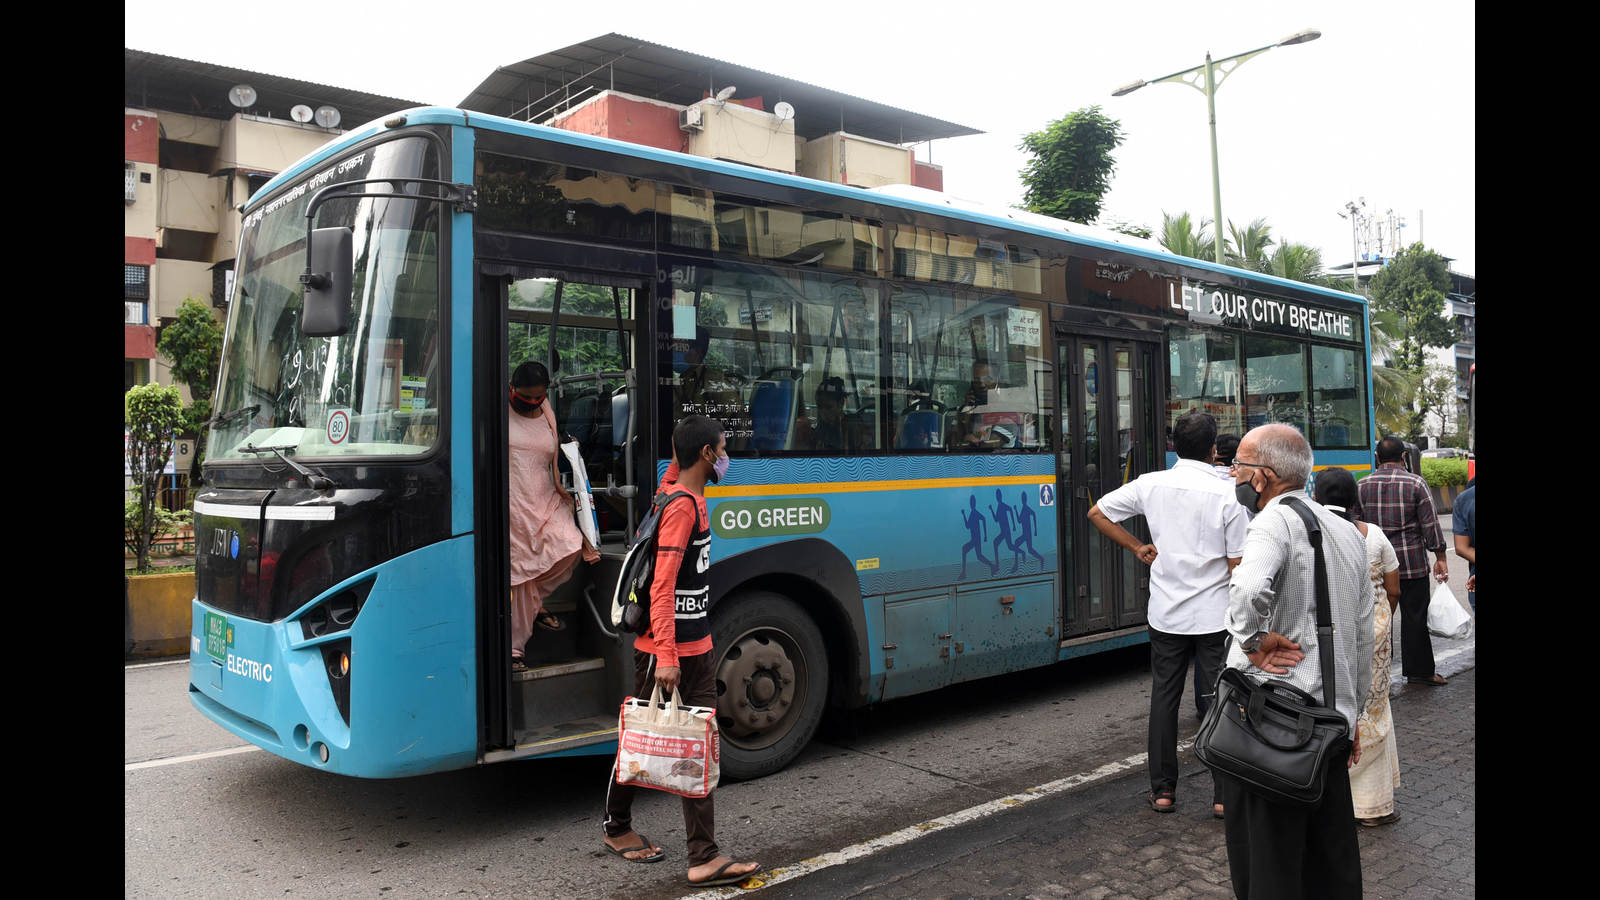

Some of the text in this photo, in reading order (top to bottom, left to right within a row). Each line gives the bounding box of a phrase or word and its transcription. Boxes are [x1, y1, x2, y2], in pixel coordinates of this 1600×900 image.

[309, 167, 337, 190] परिवहन
[338, 153, 366, 174] उपक्रम
[1170, 283, 1351, 337] LET OUR CITY BREATHE
[332, 421, 343, 433] 80
[180, 443, 188, 455] 8
[720, 510, 752, 530] GO
[757, 506, 823, 528] GREEN
